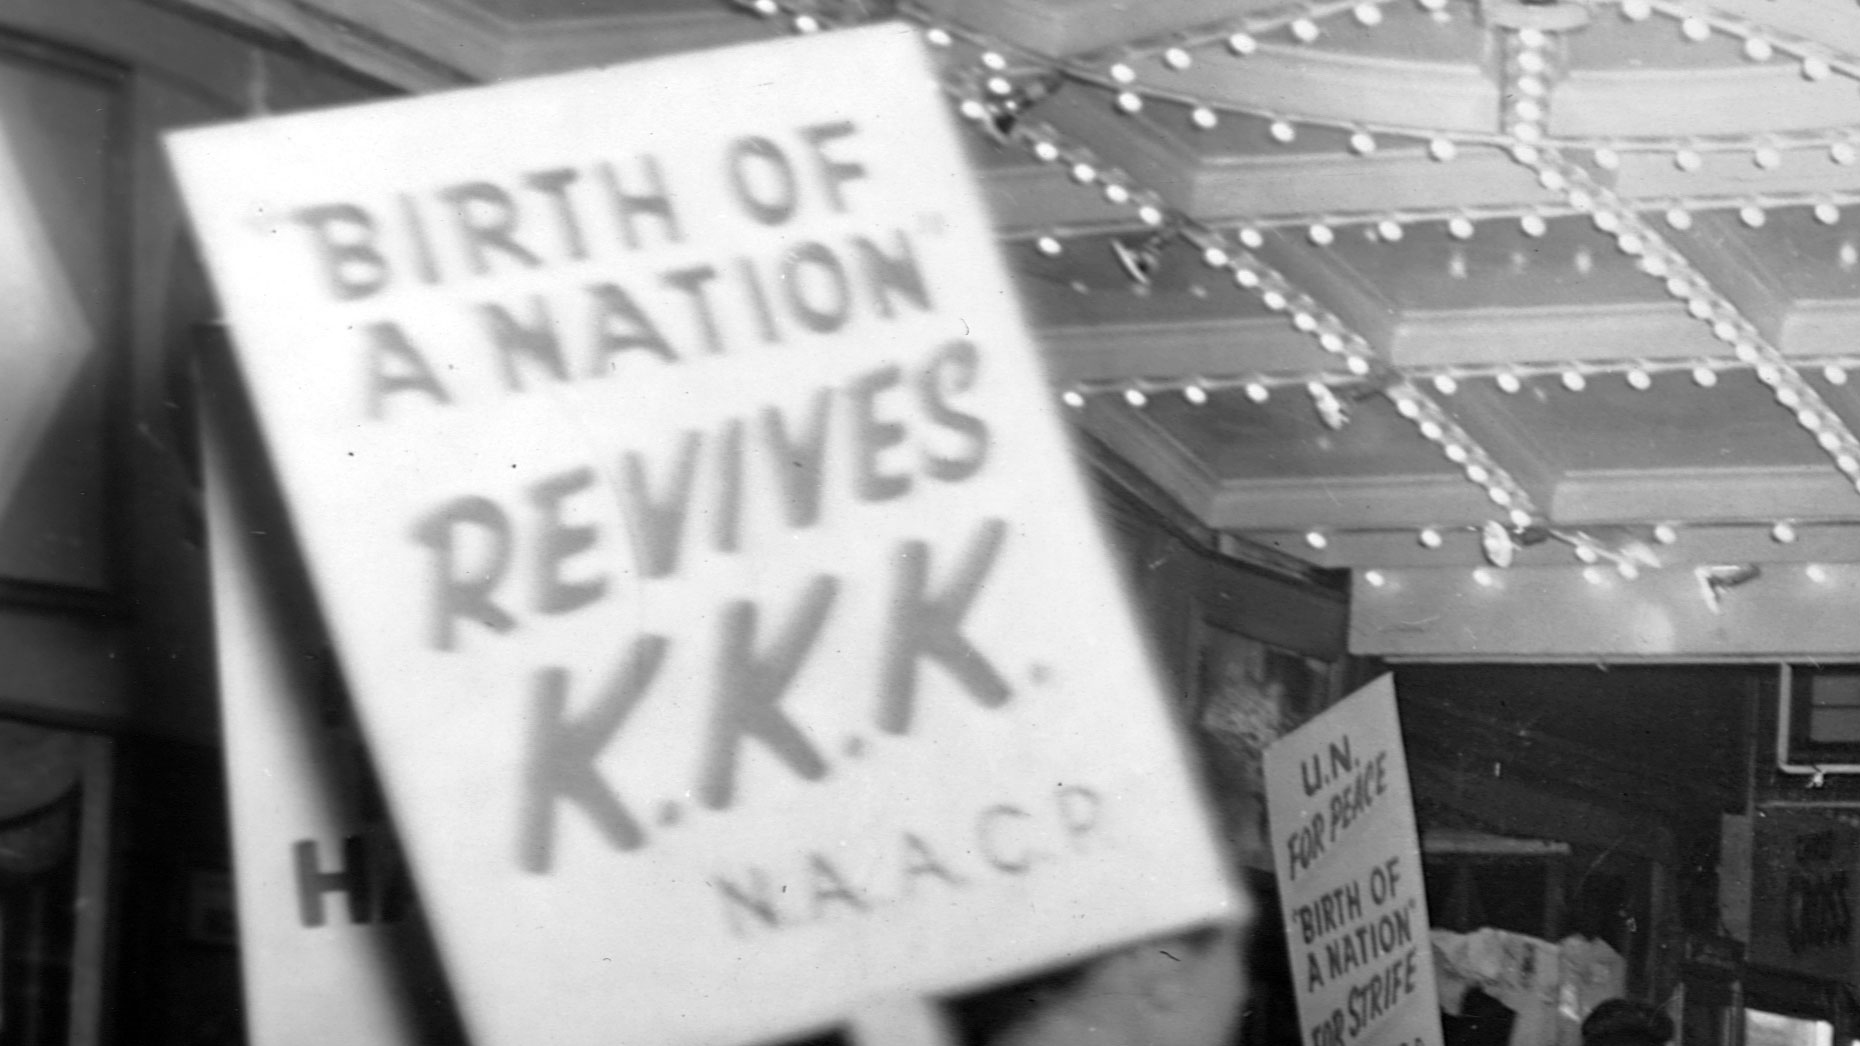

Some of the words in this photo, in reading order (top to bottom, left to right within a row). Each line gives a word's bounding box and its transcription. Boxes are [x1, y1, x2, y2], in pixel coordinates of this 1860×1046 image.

[725, 120, 868, 225] OF
[362, 322, 452, 422] A
[410, 340, 992, 652] REVIVES
[1302, 735, 1361, 798] U.N.
[1287, 813, 1325, 881] FOR
[1330, 750, 1388, 843] PEACE
[1369, 856, 1402, 906] OF
[1306, 952, 1325, 993] A
[1347, 948, 1418, 1041] STRIFE
